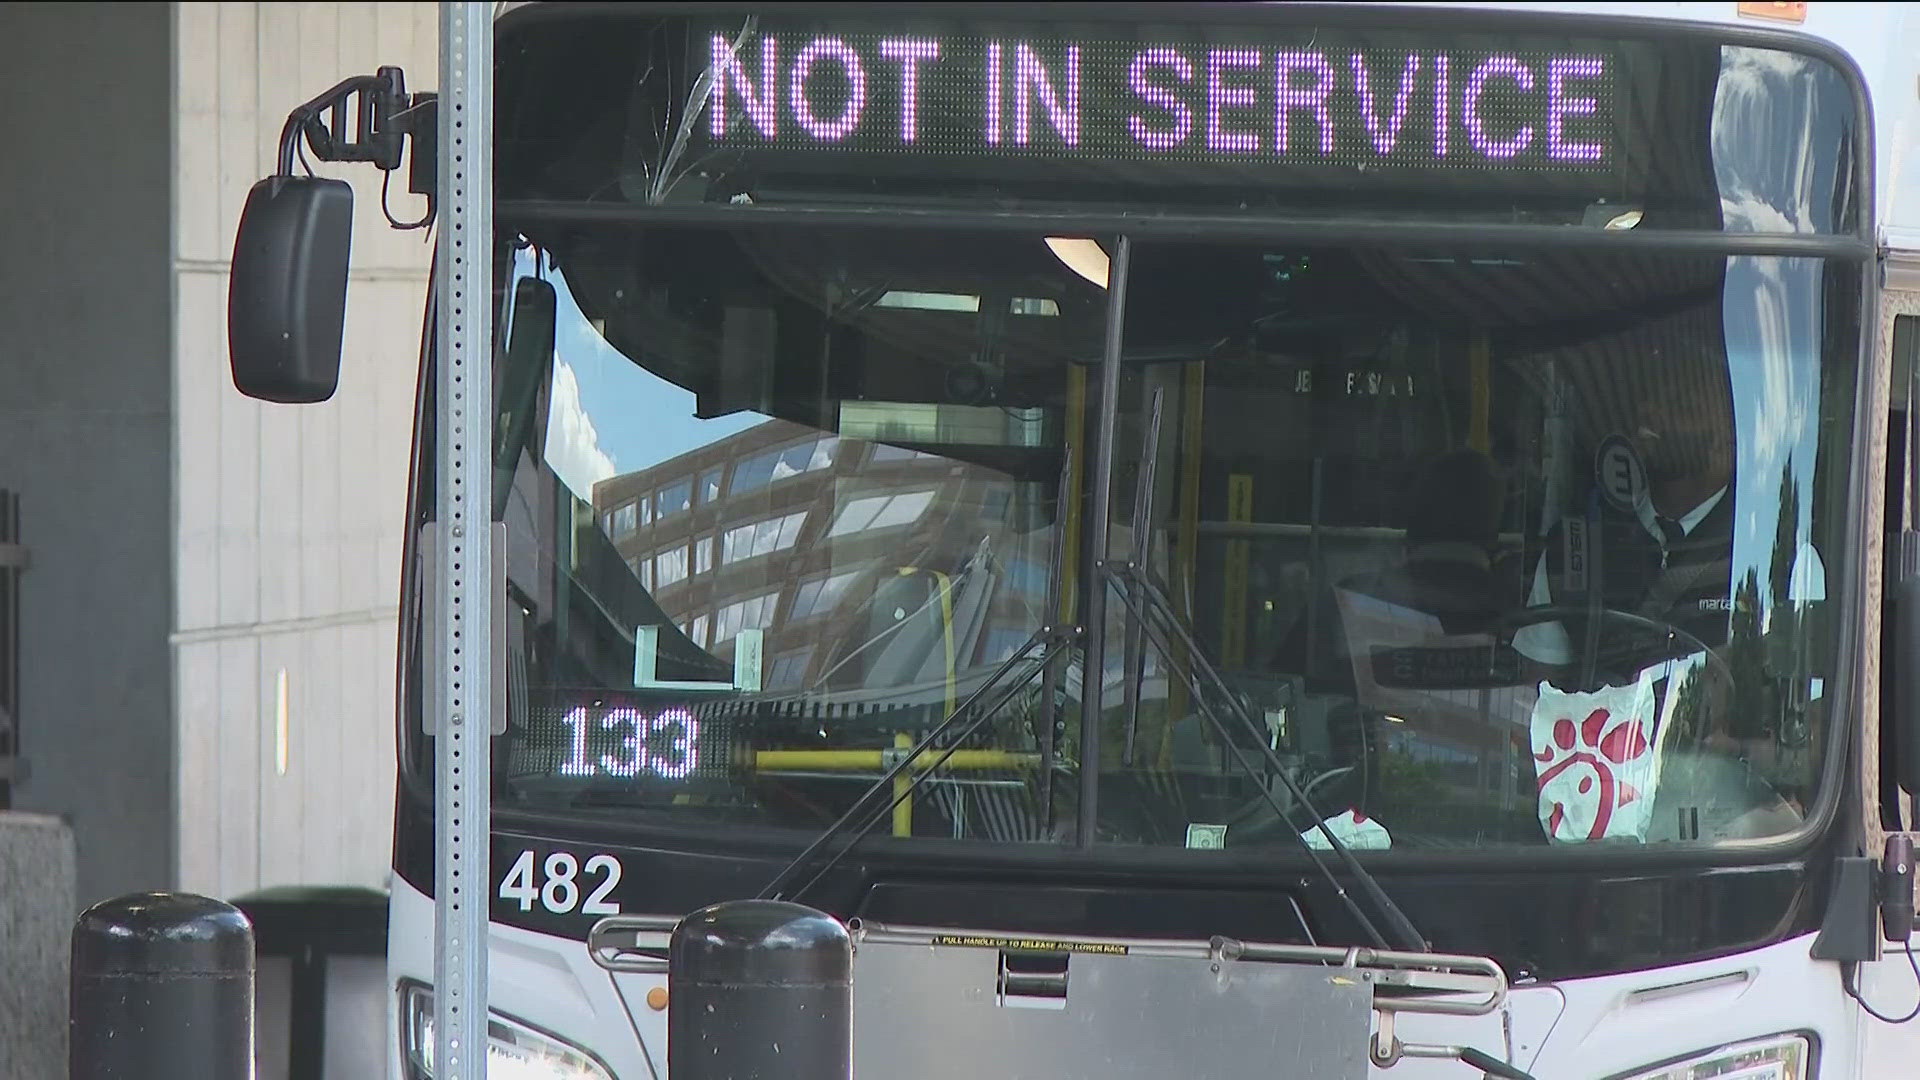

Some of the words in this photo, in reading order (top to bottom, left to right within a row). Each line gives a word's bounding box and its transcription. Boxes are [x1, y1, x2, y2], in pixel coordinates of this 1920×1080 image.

[709, 32, 940, 144] NOT
[986, 39, 1081, 149] IN
[1126, 46, 1604, 164] SERVICE
[1698, 596, 1731, 611] marta
[559, 704, 700, 780] 133
[498, 849, 623, 916] 482
[942, 936, 963, 946] PULL
[963, 937, 995, 947] HANDLE
[1009, 940, 1020, 948] TO
[1020, 940, 1056, 950] RELEASE
[1075, 943, 1103, 953] LOWER
[1104, 945, 1126, 954] RACK
